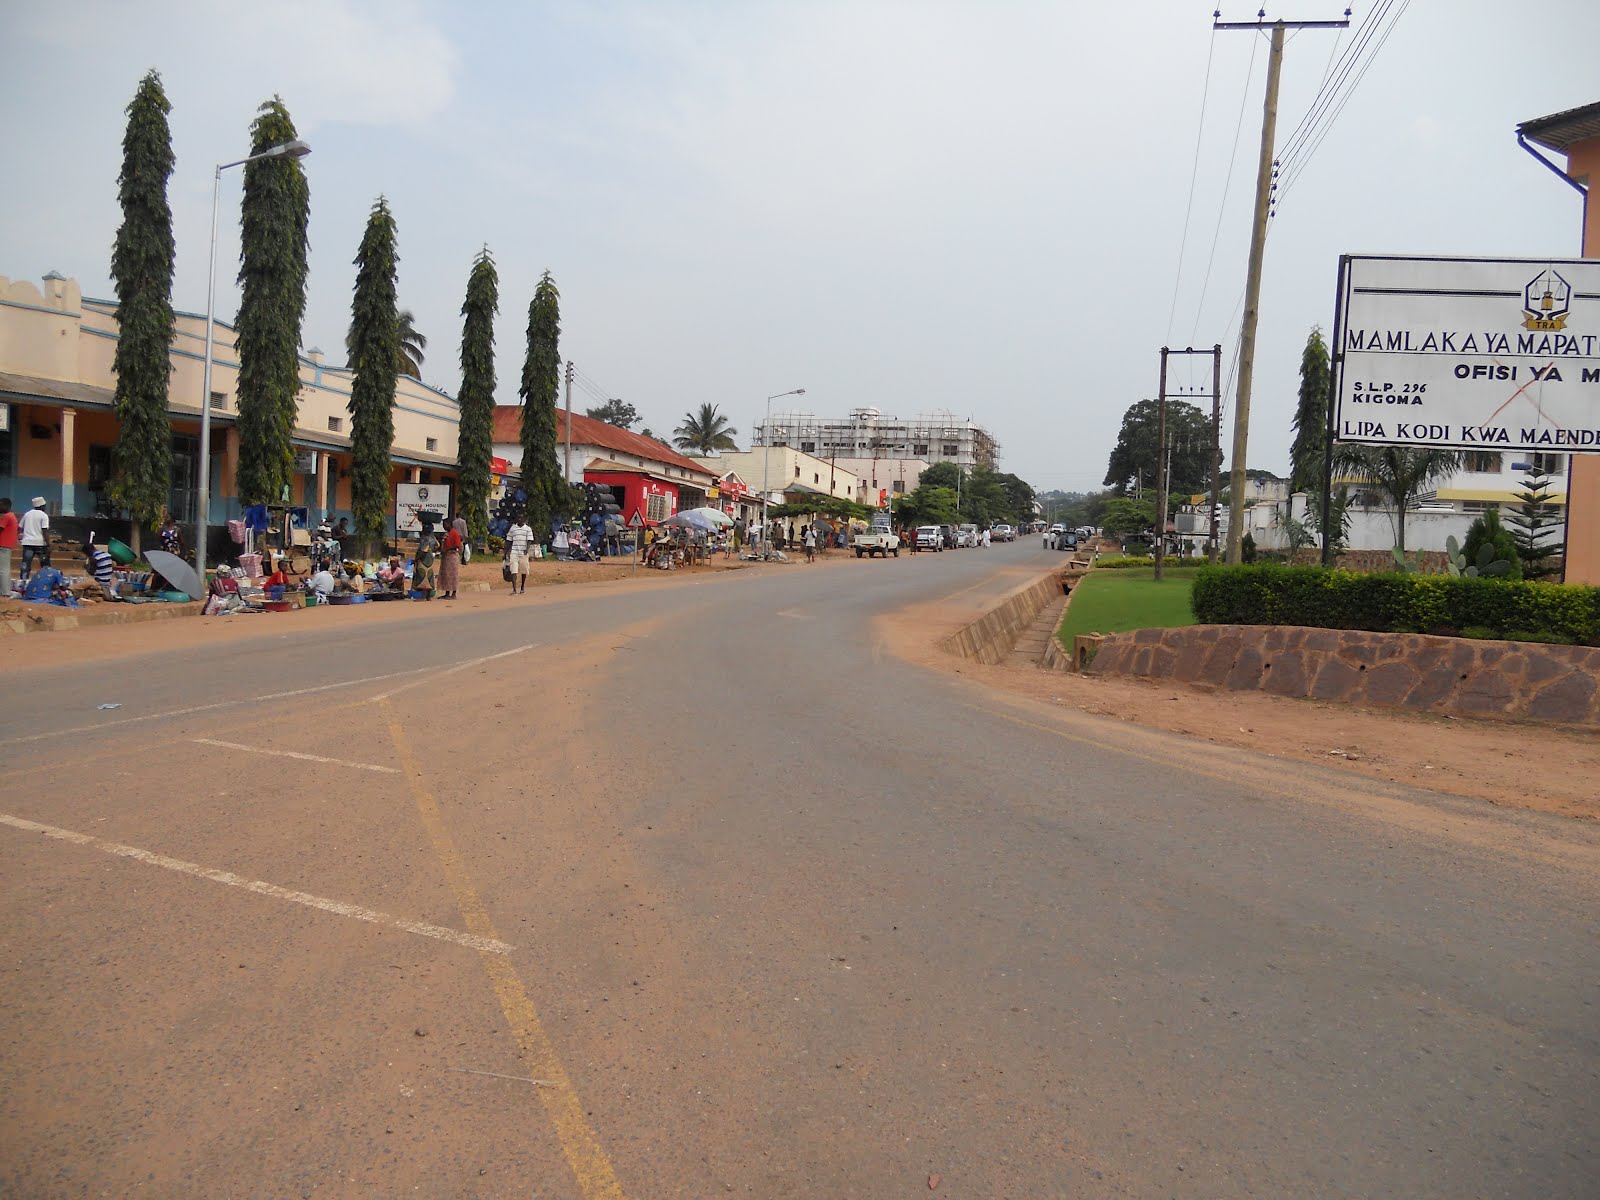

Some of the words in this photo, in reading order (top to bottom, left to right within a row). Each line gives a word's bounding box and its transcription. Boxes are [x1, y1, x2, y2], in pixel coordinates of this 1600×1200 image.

[1535, 321, 1556, 329] TRA
[1349, 329, 1479, 353] MAMLAKA
[1484, 333, 1511, 354] YA
[1517, 333, 1600, 356] MAPAT
[1454, 364, 1517, 381] OFISI
[1530, 367, 1563, 382] YA
[1353, 382, 1396, 393] S.L.P.
[1403, 383, 1427, 393] 296
[1352, 394, 1423, 405] KIGOMA
[1344, 421, 1386, 438] LIPA
[1397, 424, 1450, 440] KODI
[1461, 426, 1510, 443] KWA
